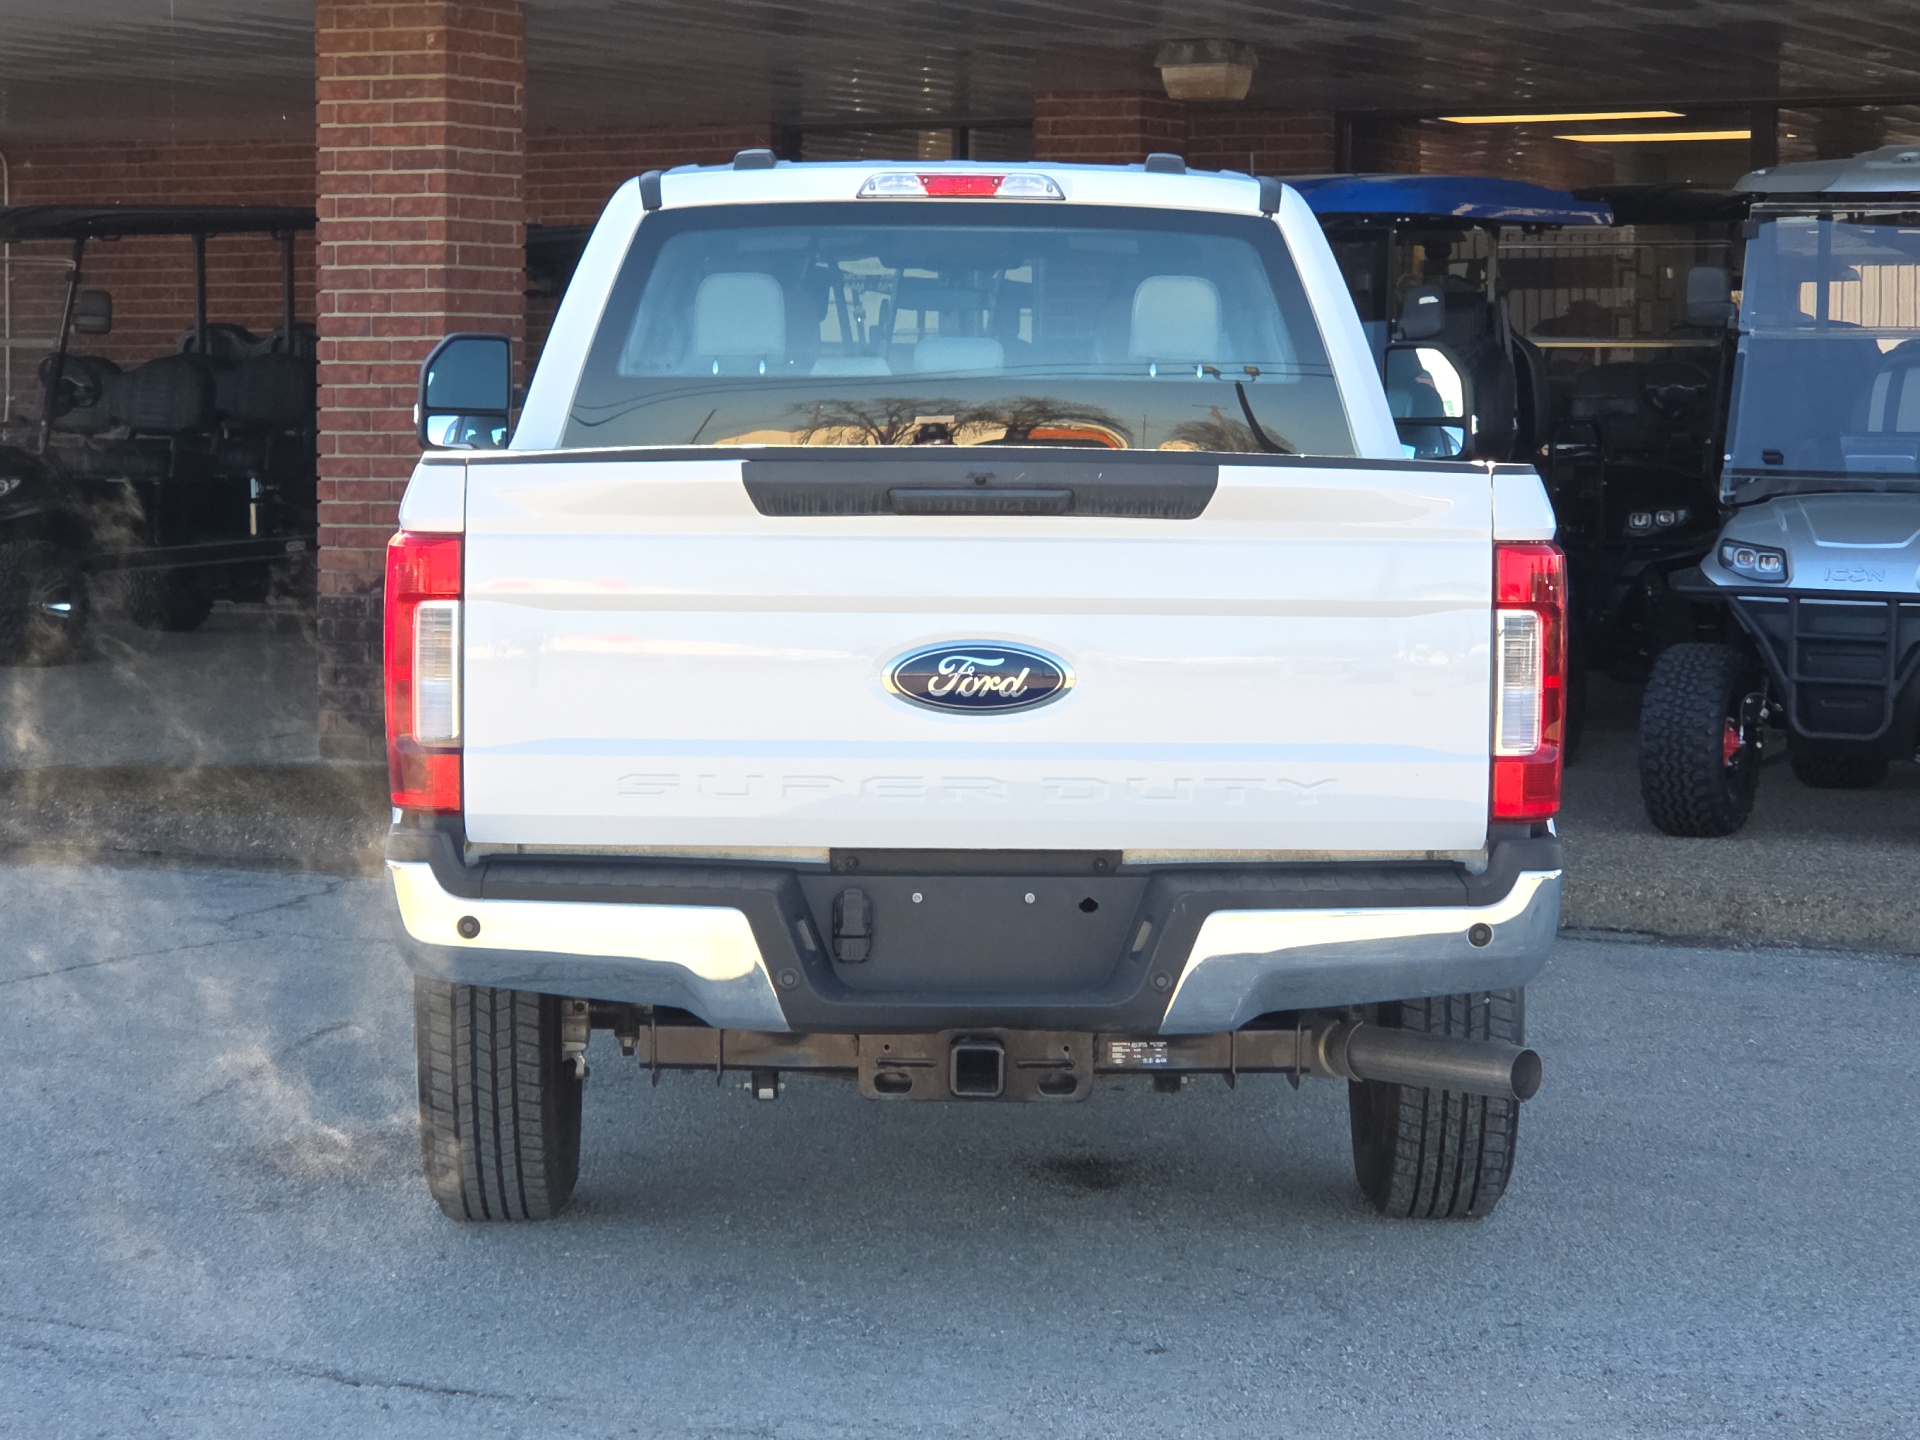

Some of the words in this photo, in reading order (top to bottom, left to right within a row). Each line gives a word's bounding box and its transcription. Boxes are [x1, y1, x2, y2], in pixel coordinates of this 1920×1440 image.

[1824, 568, 1886, 582] ICON
[927, 655, 1031, 698] Ford
[617, 773, 1006, 803] SUPER
[1042, 777, 1338, 806] DUTY
